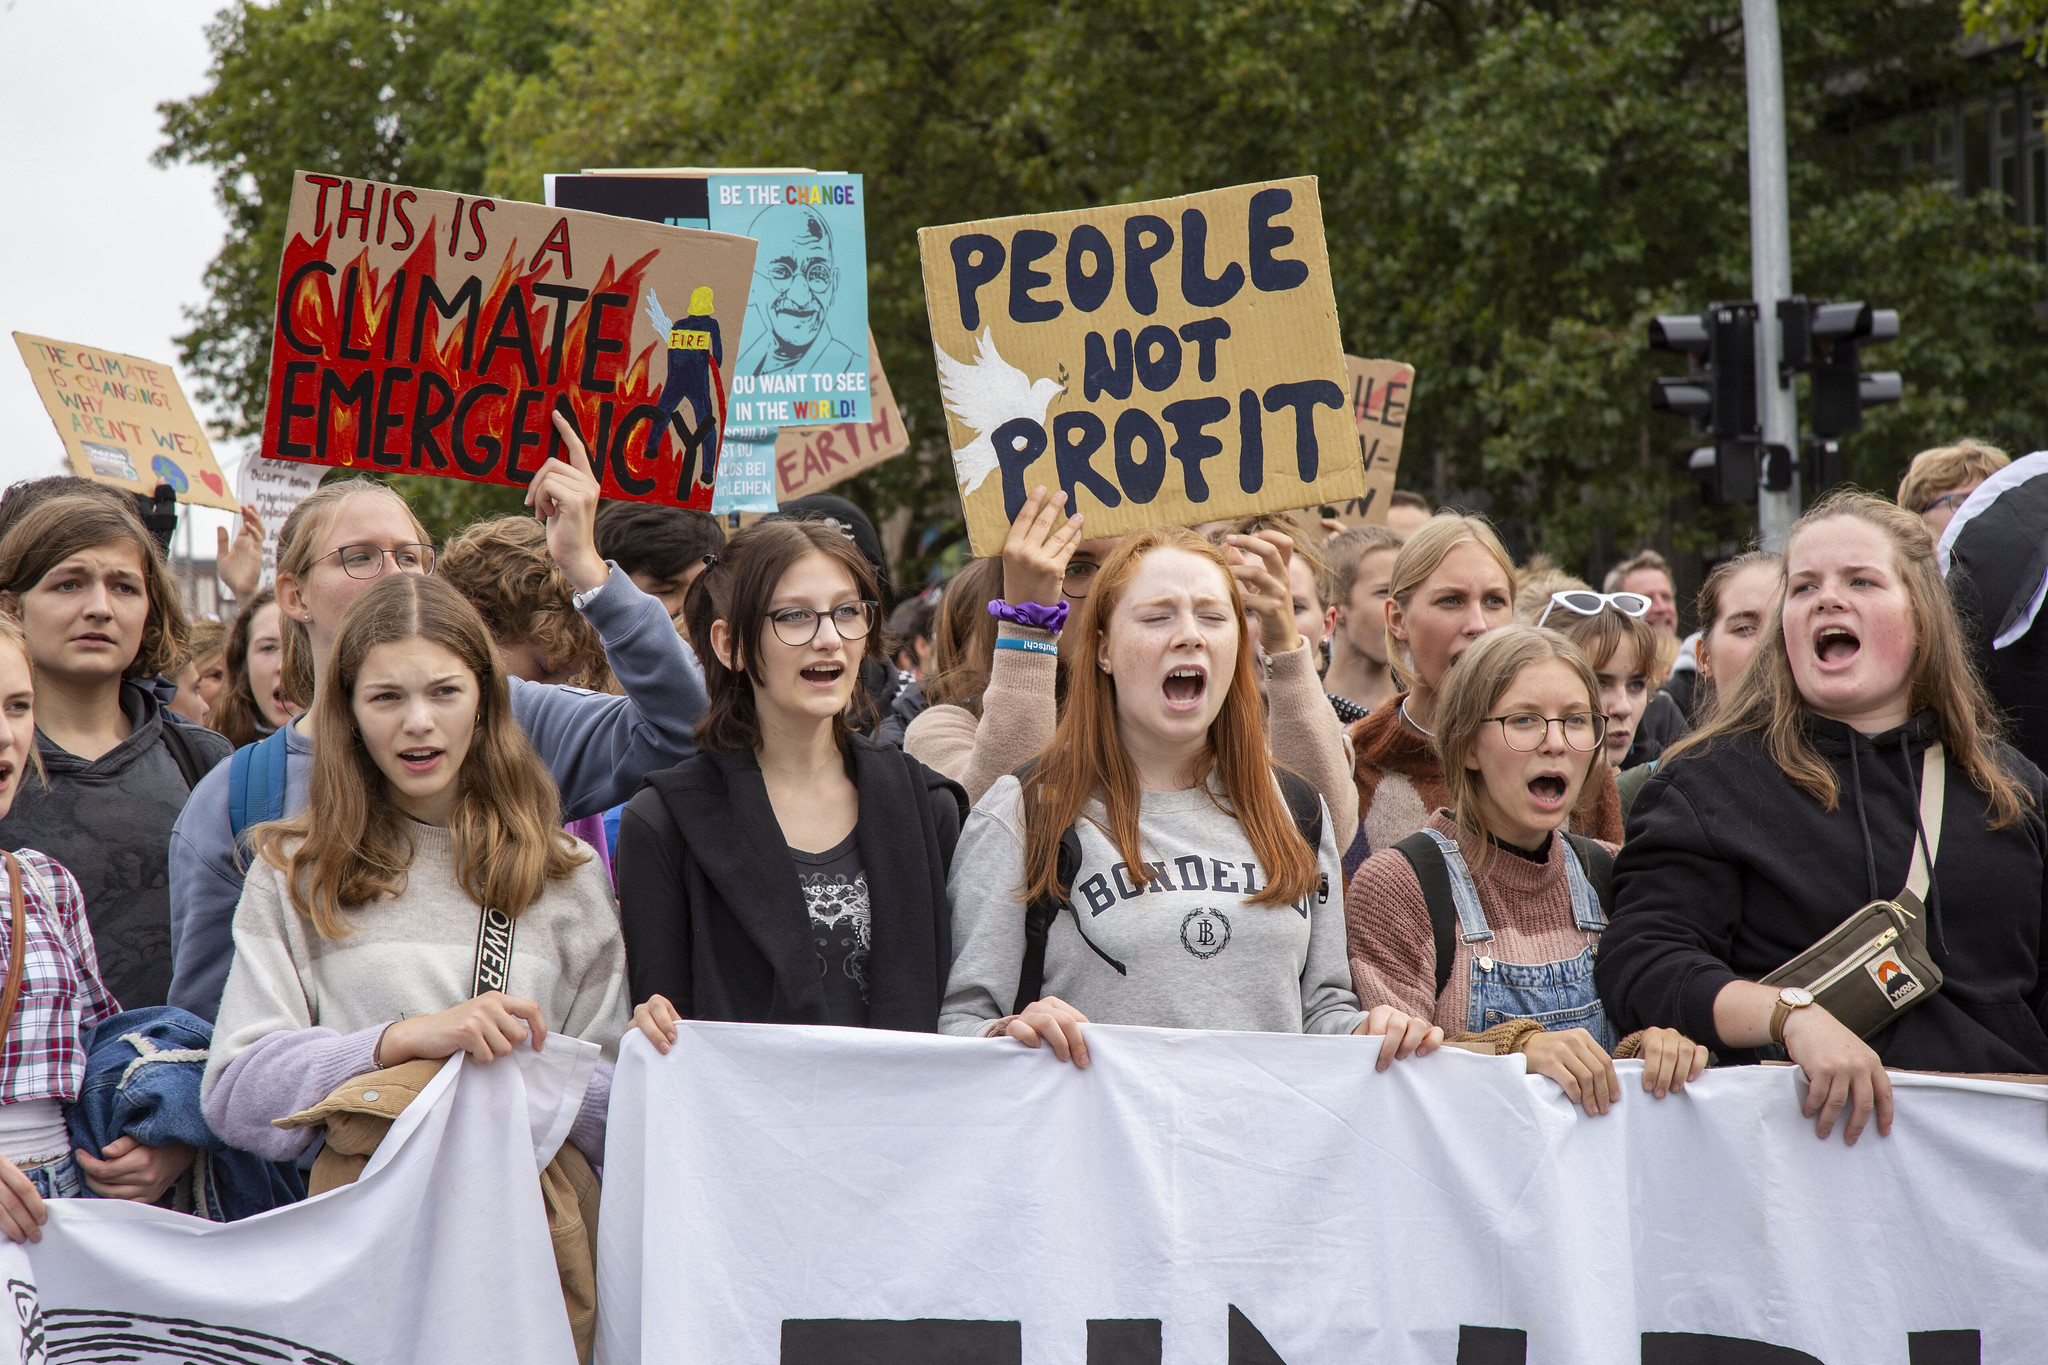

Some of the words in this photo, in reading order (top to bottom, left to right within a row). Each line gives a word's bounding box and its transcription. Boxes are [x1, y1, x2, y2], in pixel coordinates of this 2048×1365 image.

[720, 185, 743, 205] BE
[746, 185, 781, 205] THE
[785, 184, 855, 205] CHANGE
[305, 174, 418, 251] THIS
[448, 197, 496, 262] IS
[529, 217, 573, 280] A
[950, 188, 1309, 331] PEOPLE
[280, 260, 630, 394] CLIMATE
[671, 332, 706, 347] FIRE
[31, 342, 74, 368] THE
[77, 352, 165, 389] CLIMATE
[48, 367, 67, 388] IS
[1084, 317, 1231, 402] NOT
[57, 389, 104, 415] WHY
[733, 375, 755, 395] OU
[759, 373, 808, 394] WANT
[811, 373, 833, 392] TO
[836, 372, 867, 392] SEE
[1354, 374, 1408, 428] ILE
[276, 360, 716, 502] EMERGENCY
[735, 402, 753, 421] IN
[756, 401, 789, 421] THE
[792, 399, 856, 419] WORLD!
[71, 412, 143, 446] AREN'T
[151, 427, 203, 460] WE?
[720, 443, 735, 458] ST
[738, 443, 753, 457] DU
[776, 406, 892, 494] EARTH
[991, 379, 1345, 526] PROFIT
[717, 461, 743, 477] NLOS
[746, 461, 767, 476] BEI
[480, 907, 510, 990] OWER
[1891, 981, 1917, 999] YKRA
